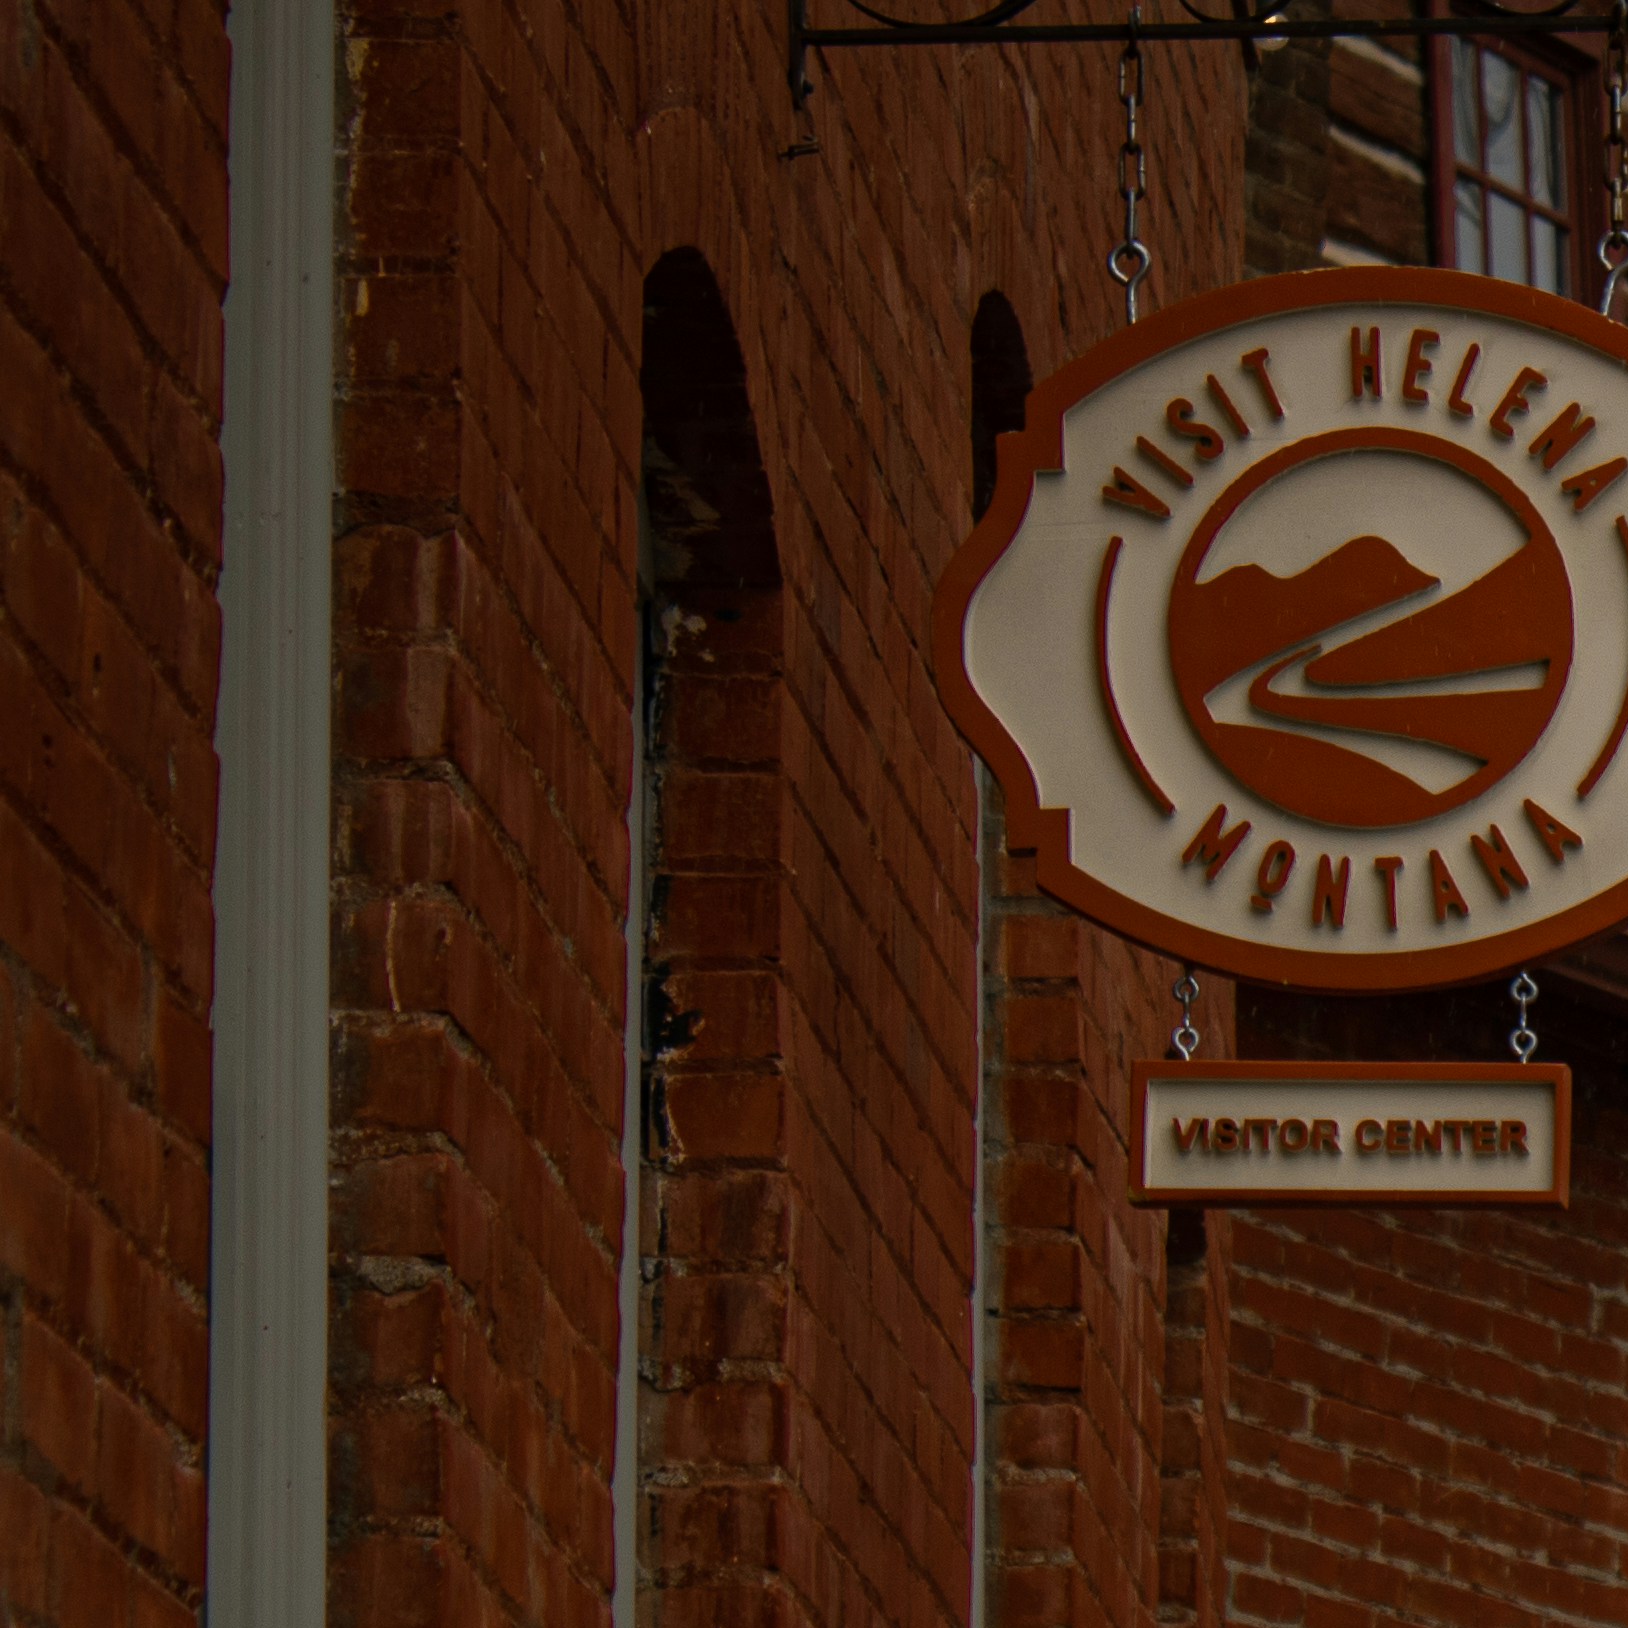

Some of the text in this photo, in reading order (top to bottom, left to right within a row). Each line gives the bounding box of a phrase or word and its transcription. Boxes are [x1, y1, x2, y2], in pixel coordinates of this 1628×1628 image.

[1101, 325, 1628, 518] VISIT HELENA
[1181, 798, 1583, 928] MONTANA
[1172, 1116, 1528, 1156] VISITOR CENTER
